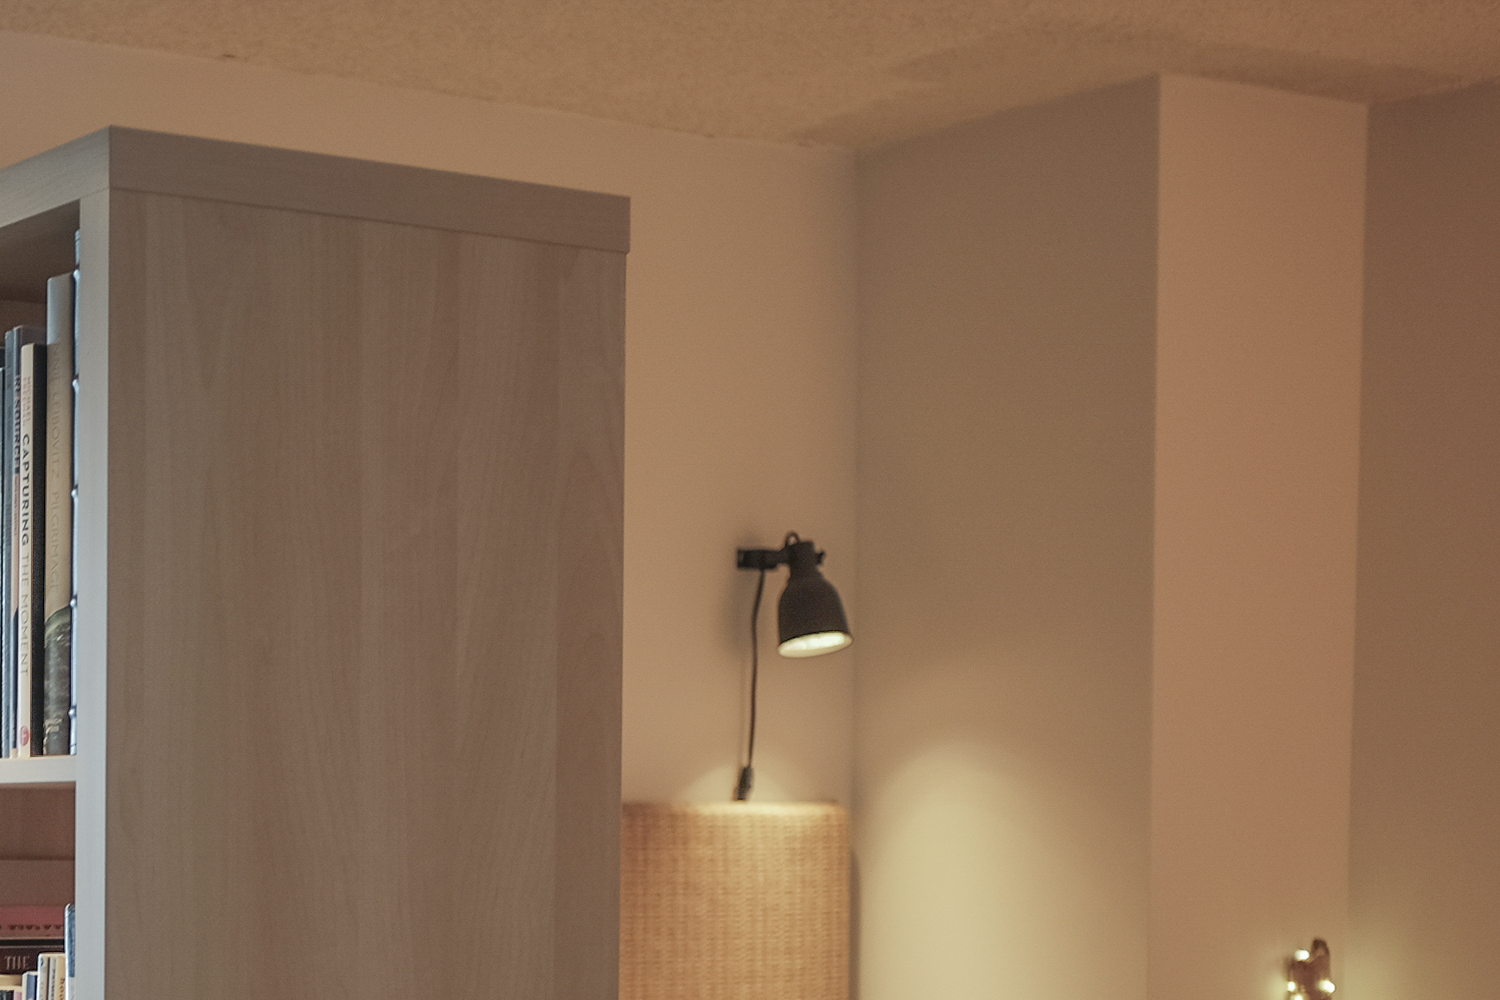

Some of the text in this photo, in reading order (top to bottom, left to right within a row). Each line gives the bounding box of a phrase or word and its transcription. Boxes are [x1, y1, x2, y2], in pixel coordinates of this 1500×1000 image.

[20, 433, 30, 677] CAPTURING THE MOMENT
[50, 491, 61, 592] PILGRIMAGE
[3, 955, 31, 970] THE
